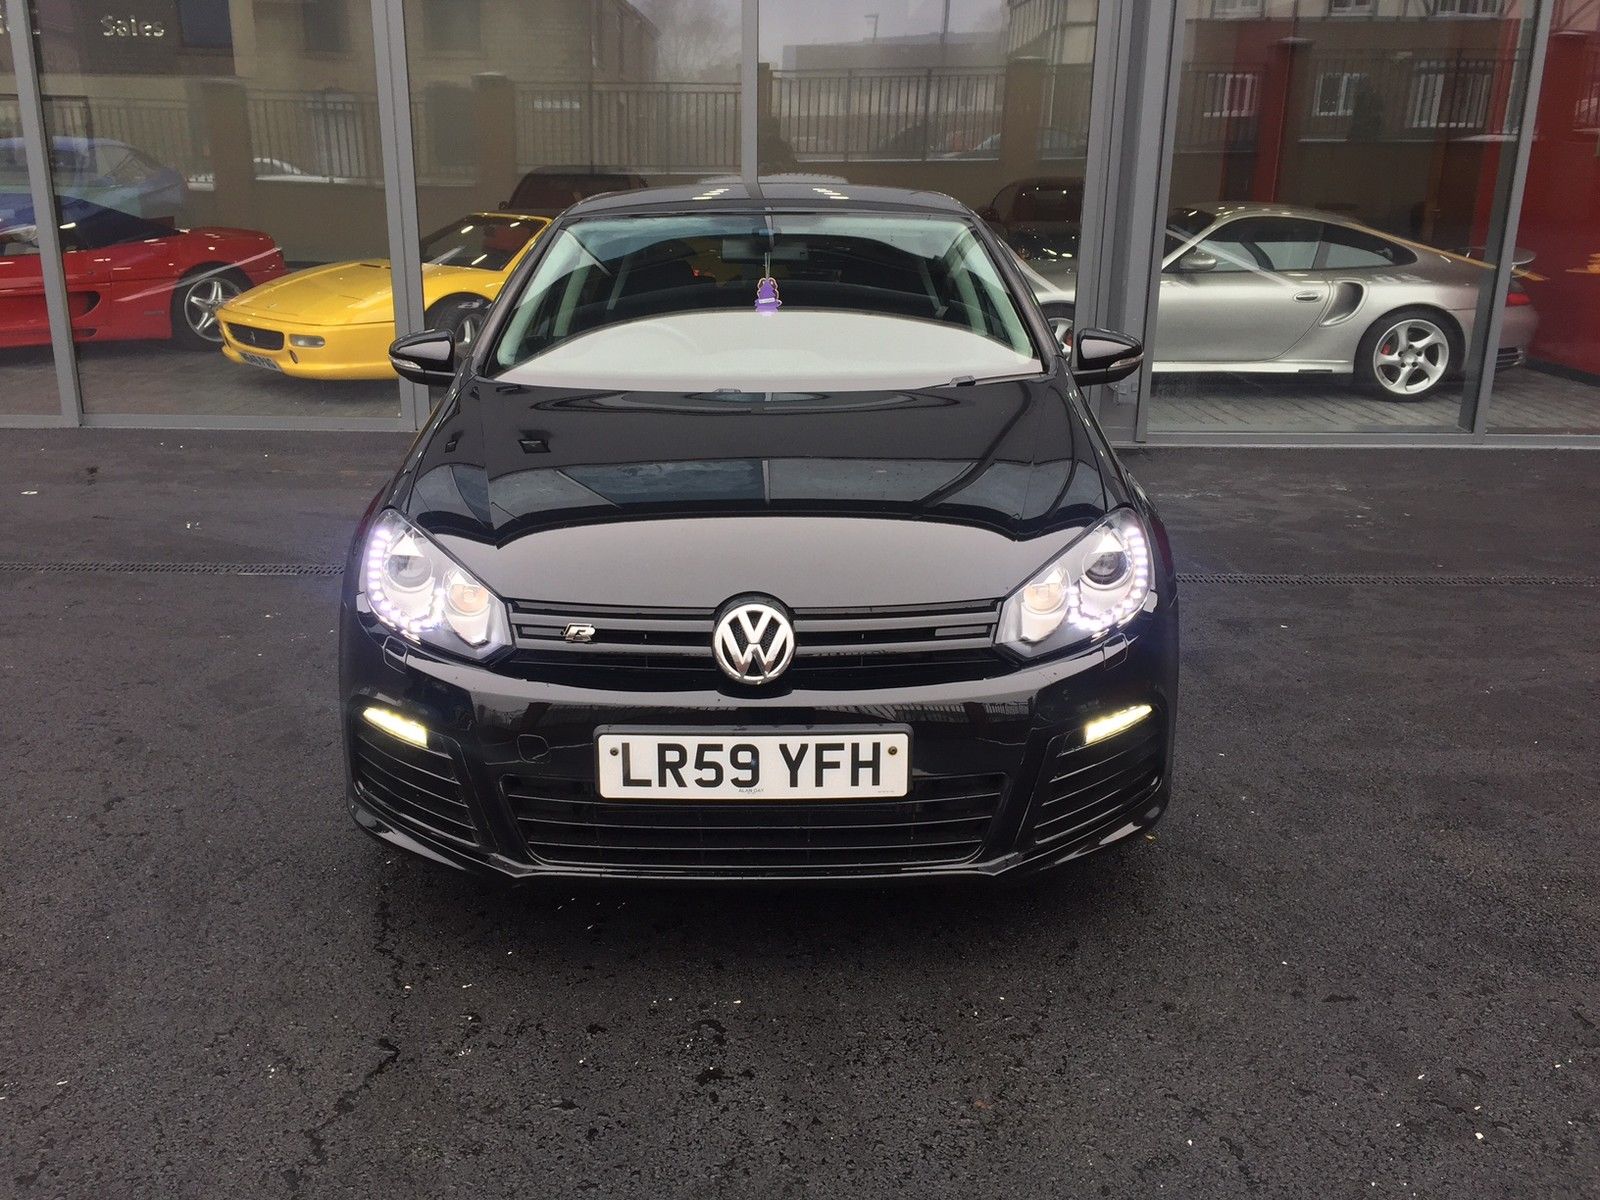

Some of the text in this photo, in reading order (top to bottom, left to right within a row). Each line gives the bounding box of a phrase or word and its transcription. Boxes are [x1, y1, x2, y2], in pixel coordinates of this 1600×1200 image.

[101, 15, 165, 37] Sales
[621, 742, 881, 788] LR59 YFH
